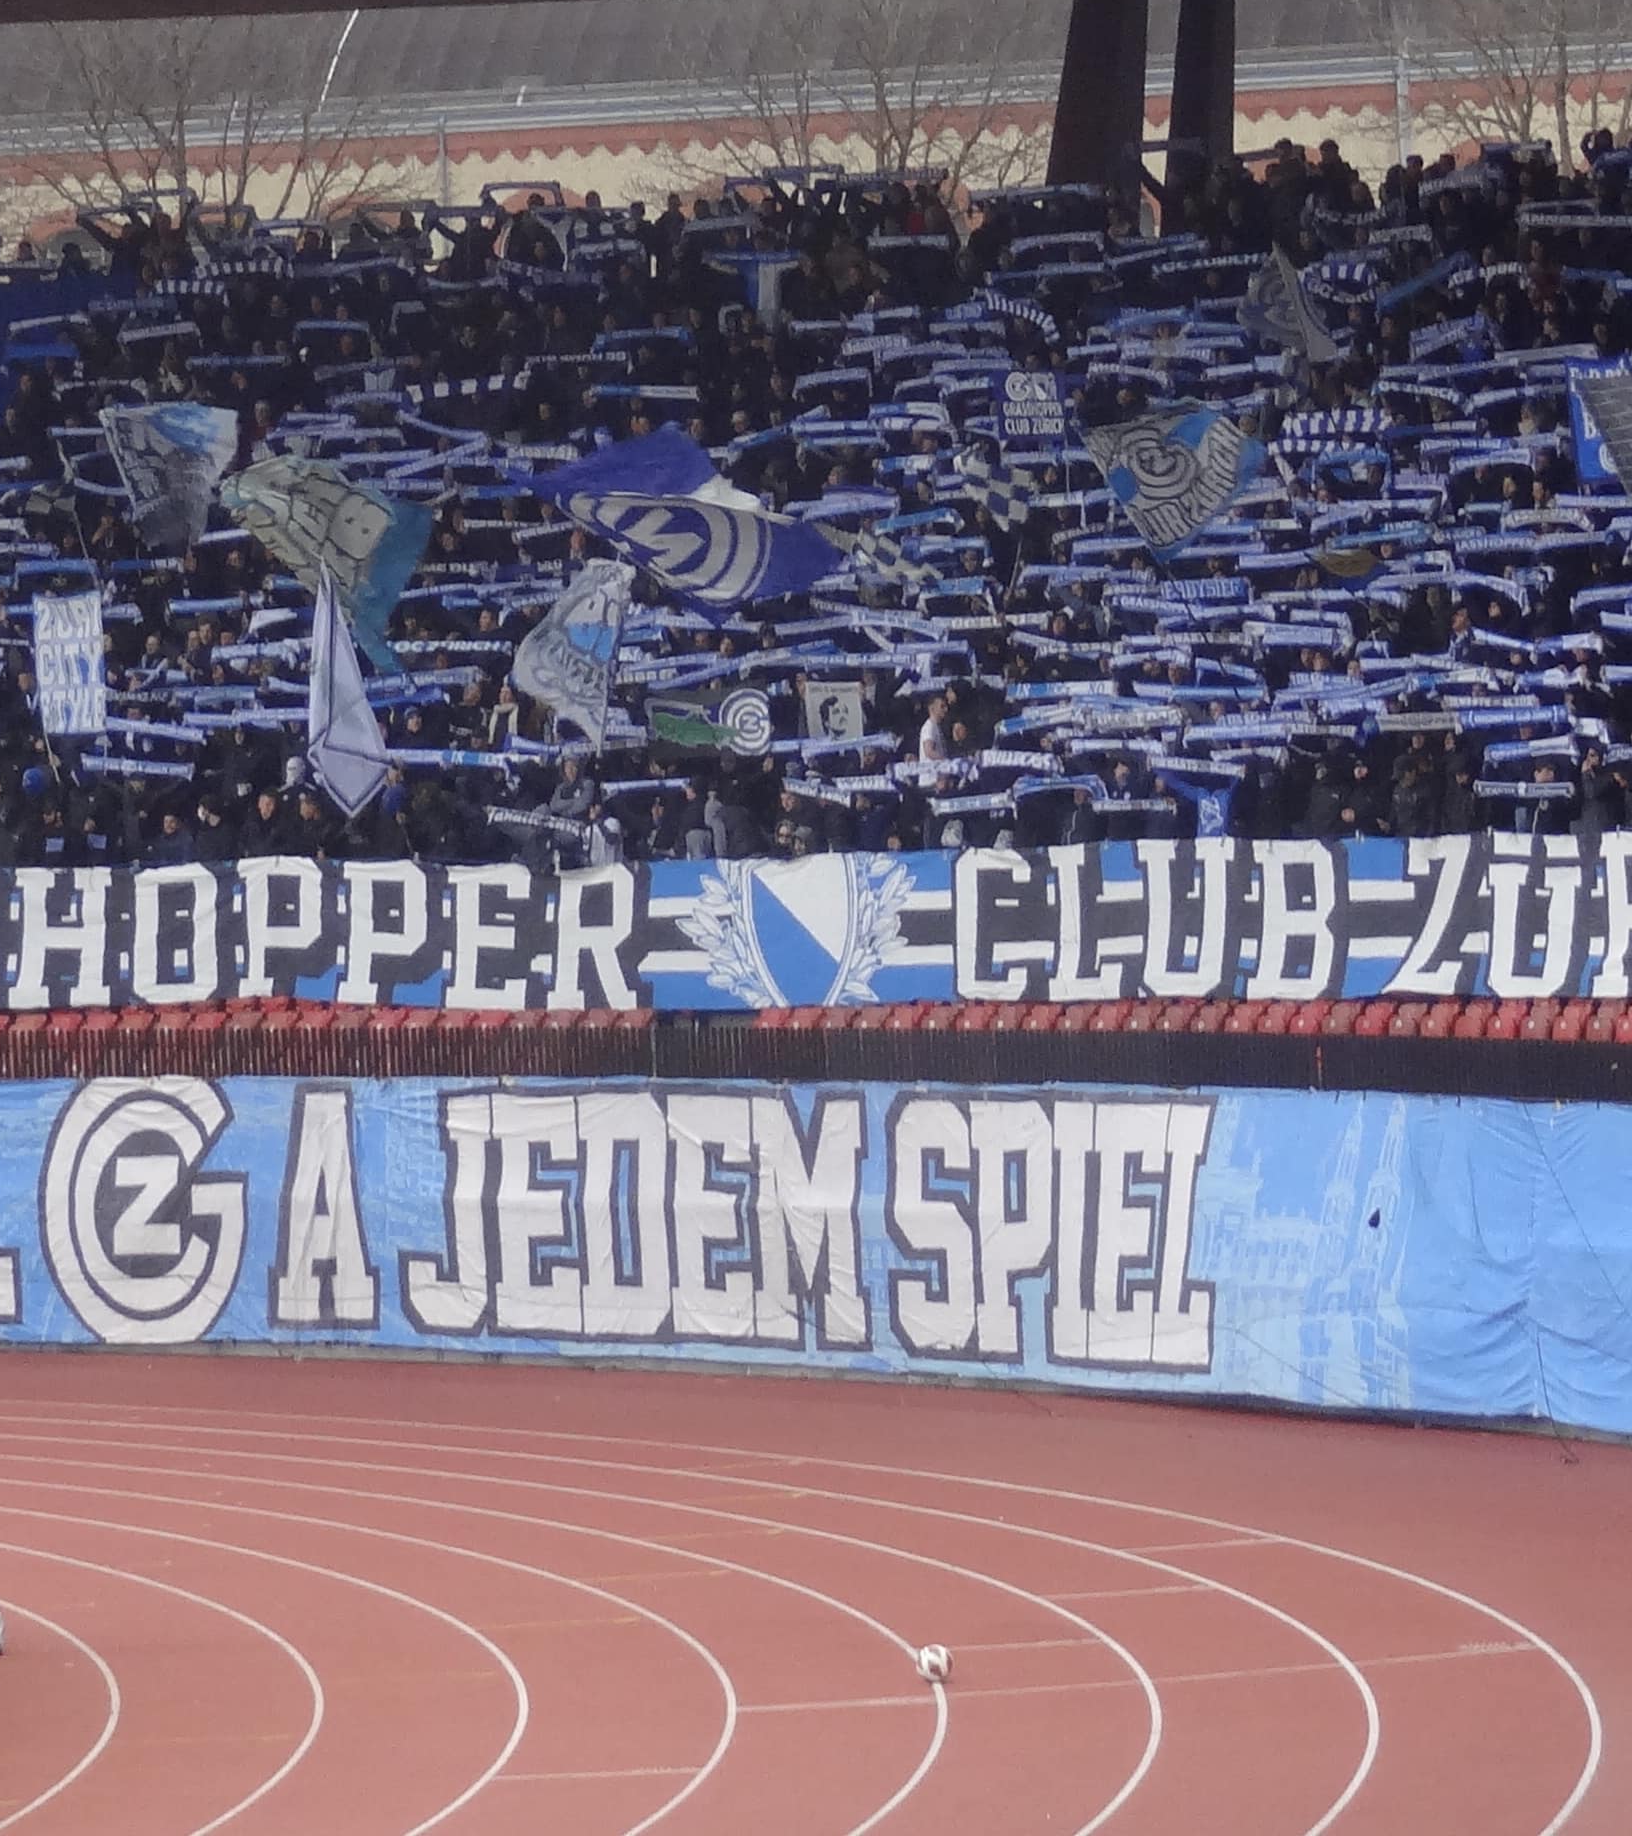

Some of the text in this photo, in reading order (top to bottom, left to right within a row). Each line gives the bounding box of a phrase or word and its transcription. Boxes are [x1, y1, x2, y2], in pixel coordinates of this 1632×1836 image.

[38, 642, 101, 690] CITY
[955, 838, 1340, 1004] CLUB
[271, 1082, 379, 1331] A
[398, 1086, 874, 1352] JEDEM
[884, 1089, 1219, 1374] SPIEL
